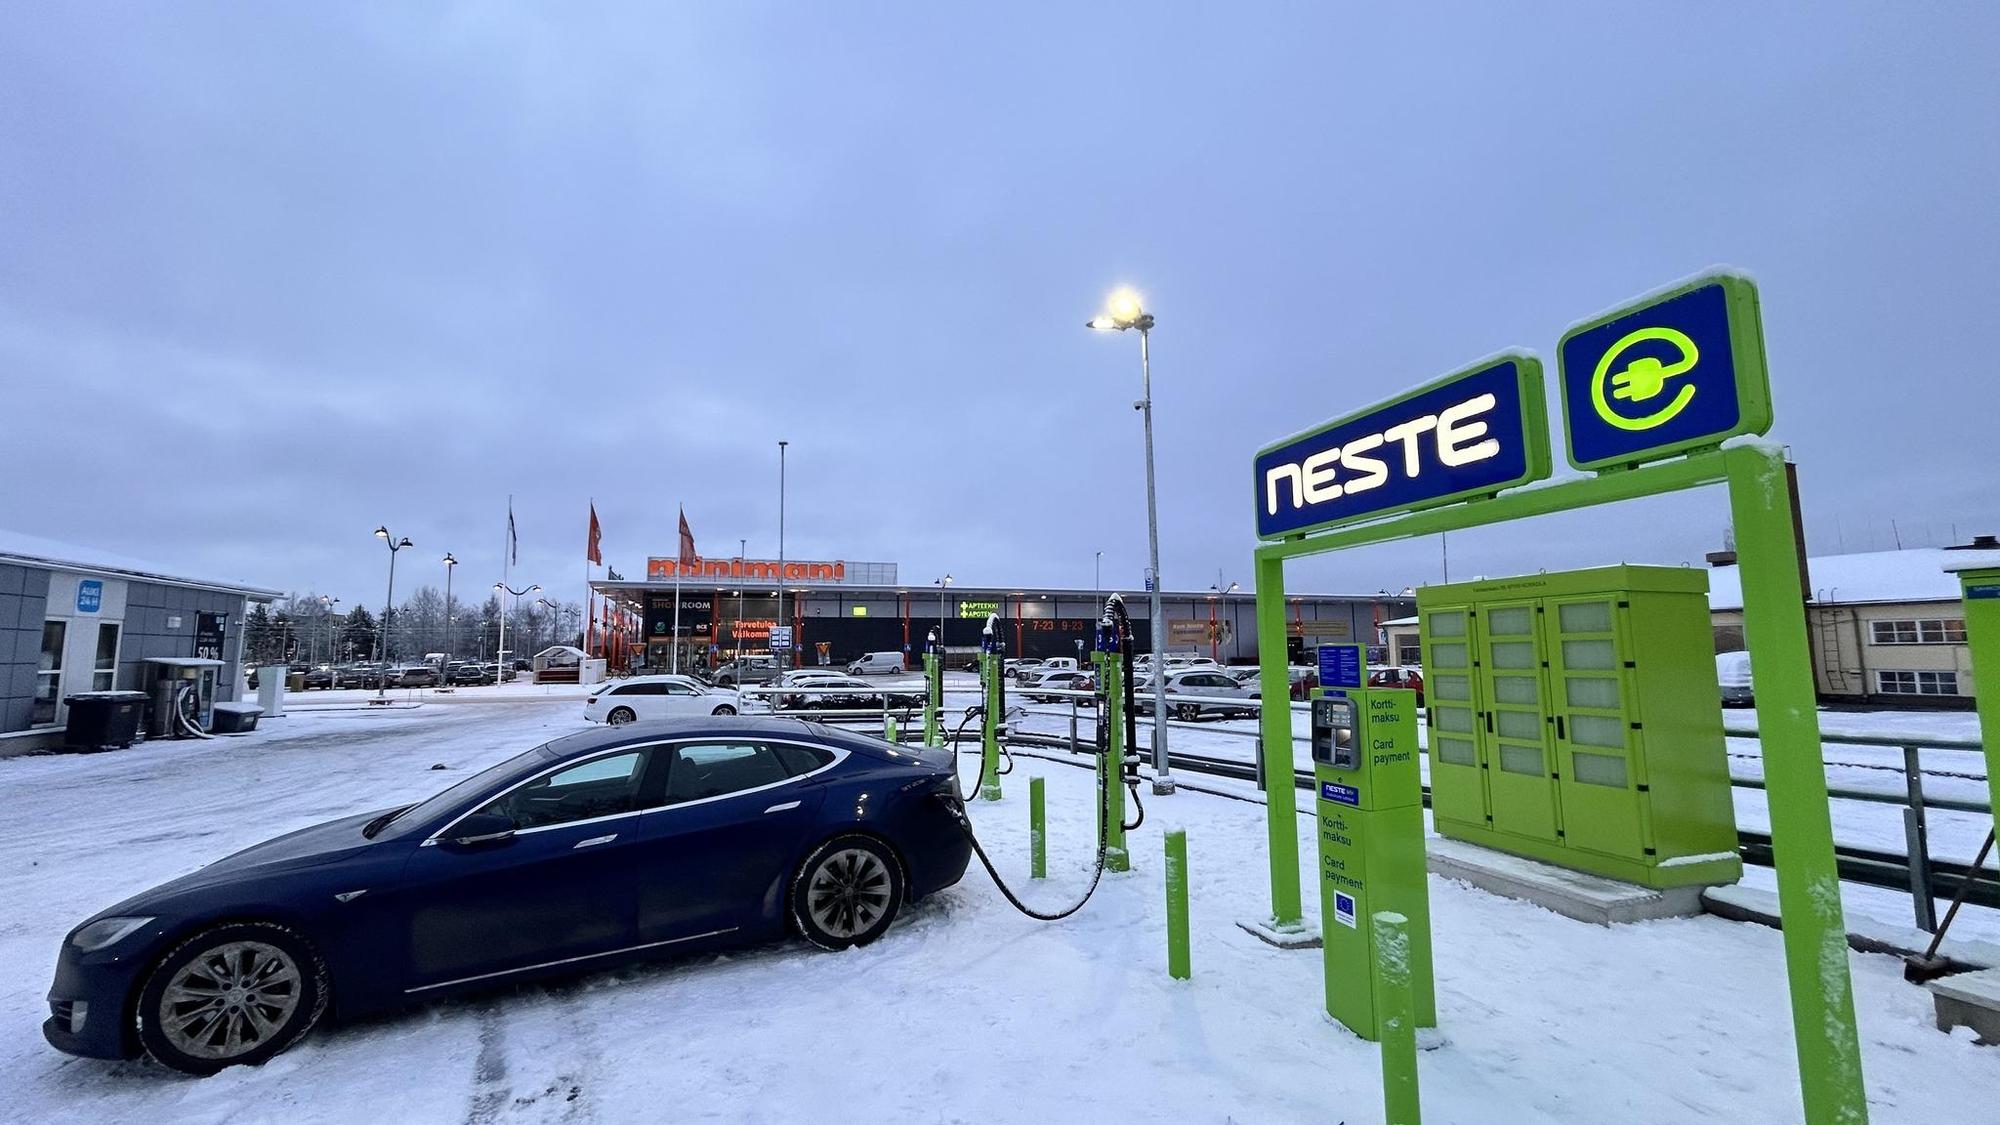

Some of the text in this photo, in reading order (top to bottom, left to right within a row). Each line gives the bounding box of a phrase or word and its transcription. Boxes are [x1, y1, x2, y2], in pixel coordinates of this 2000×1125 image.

[1266, 393, 1500, 516] NESTE
[968, 602, 999, 610] APTEEKKI
[1032, 620, 1084, 631] 7-23 9-23
[732, 630, 770, 639] Välkomm
[198, 646, 209, 660] 50
[1370, 699, 1396, 710] Kortti-
[1371, 712, 1400, 723] maksu
[1372, 738, 1394, 750] Card
[1373, 751, 1410, 766] payment
[1325, 784, 1346, 795] NESTE
[1322, 816, 1348, 831] Kortti-
[1323, 831, 1352, 847] maksu
[1324, 855, 1345, 870] Card
[1325, 870, 1364, 891] payment
